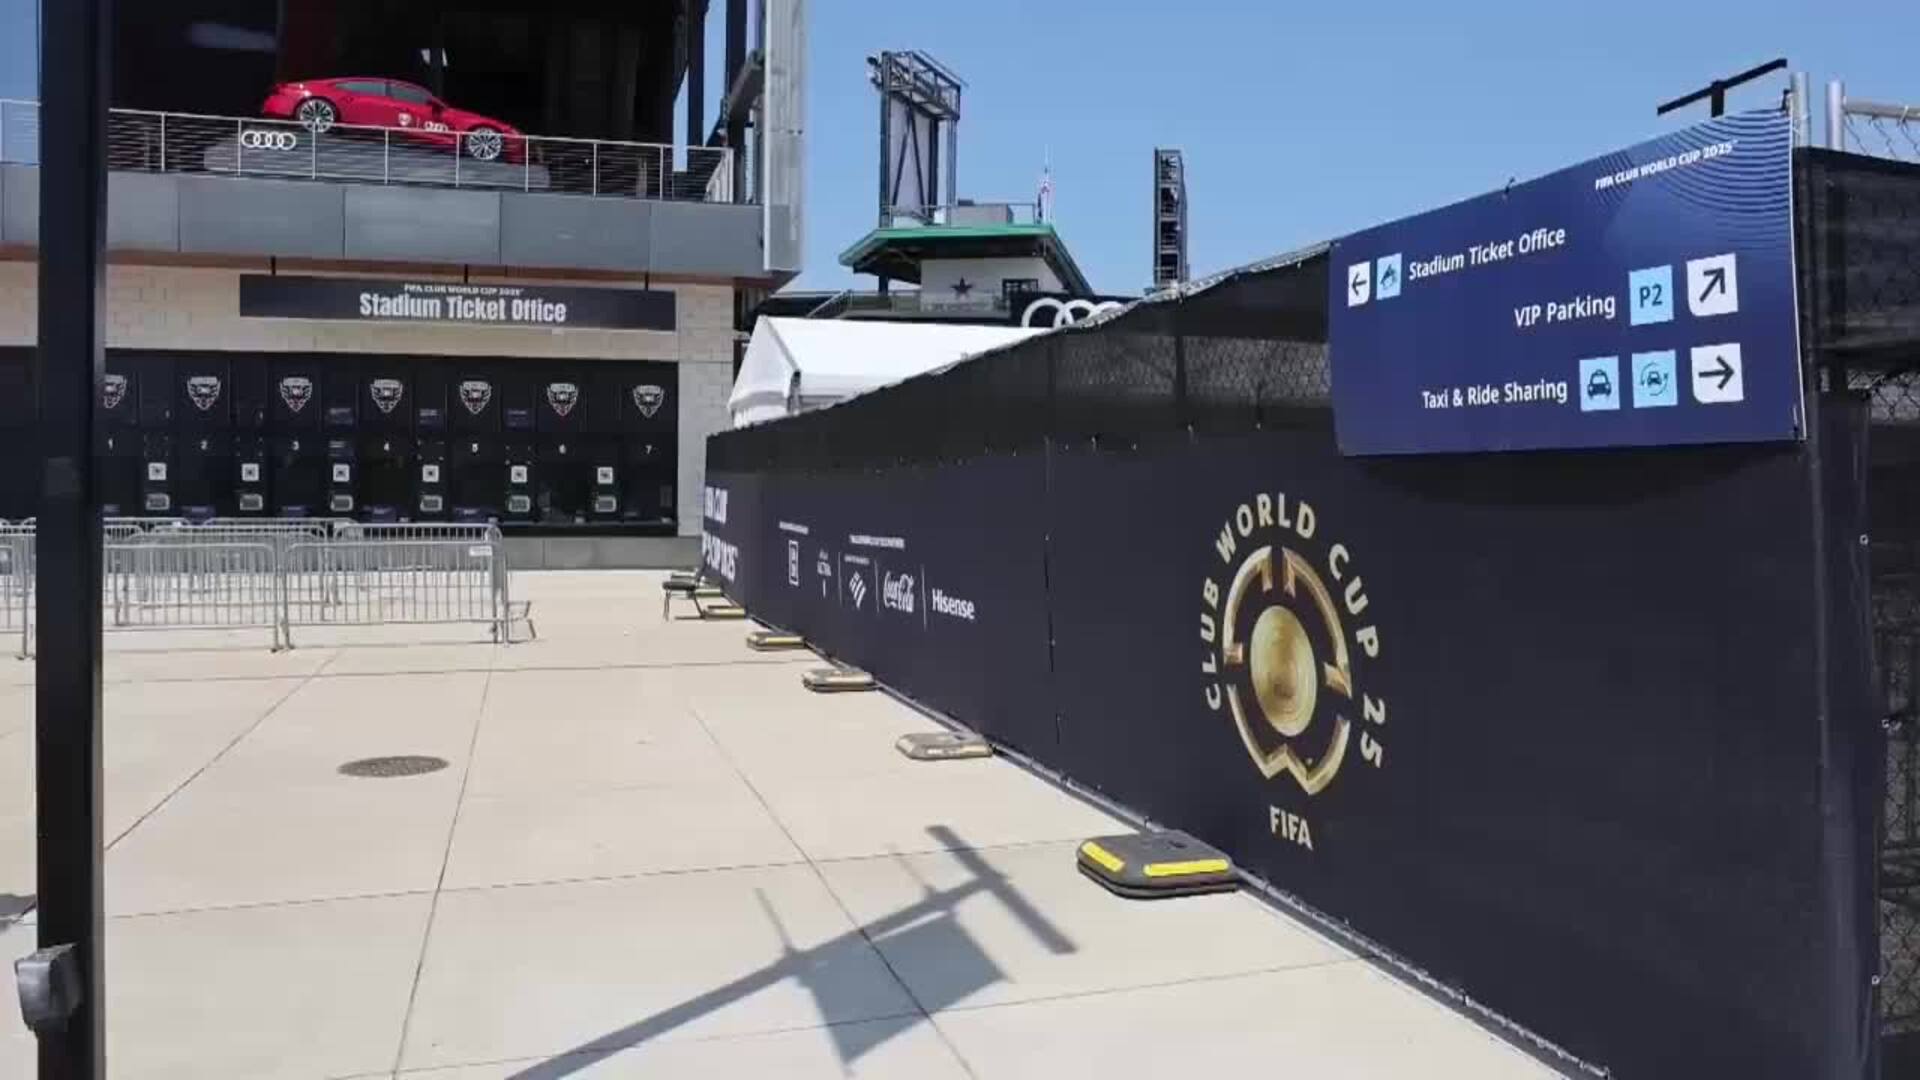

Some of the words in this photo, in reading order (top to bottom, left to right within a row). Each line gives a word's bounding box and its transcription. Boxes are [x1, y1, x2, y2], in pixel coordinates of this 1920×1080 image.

[1595, 177, 1614, 190] FIFA
[1615, 168, 1639, 184] CLUB
[1640, 156, 1678, 177] WORLD
[1678, 150, 1701, 166] CUP
[1409, 253, 1465, 280] Stadium
[1469, 239, 1514, 265] Ticket
[1518, 228, 1566, 253] Office
[359, 292, 441, 318] Stadium
[446, 295, 506, 321] Ticket
[511, 298, 567, 323] Office
[448, 286, 479, 295] WORLD
[480, 287, 498, 296] CUP
[1514, 306, 1541, 328] VIP
[1547, 295, 1616, 323] Parking
[1639, 284, 1664, 308] P2
[1422, 388, 1449, 409] Taxi
[1453, 390, 1463, 406] &
[1468, 384, 1499, 406] Ride
[1504, 379, 1568, 404] Sharing
[931, 588, 976, 620] Hisense
[1200, 576, 1222, 711] CLUB
[1215, 492, 1316, 565] WORLD
[1328, 543, 1380, 658] CUP
[1360, 693, 1386, 768] 25
[1270, 804, 1314, 851] FIFA
